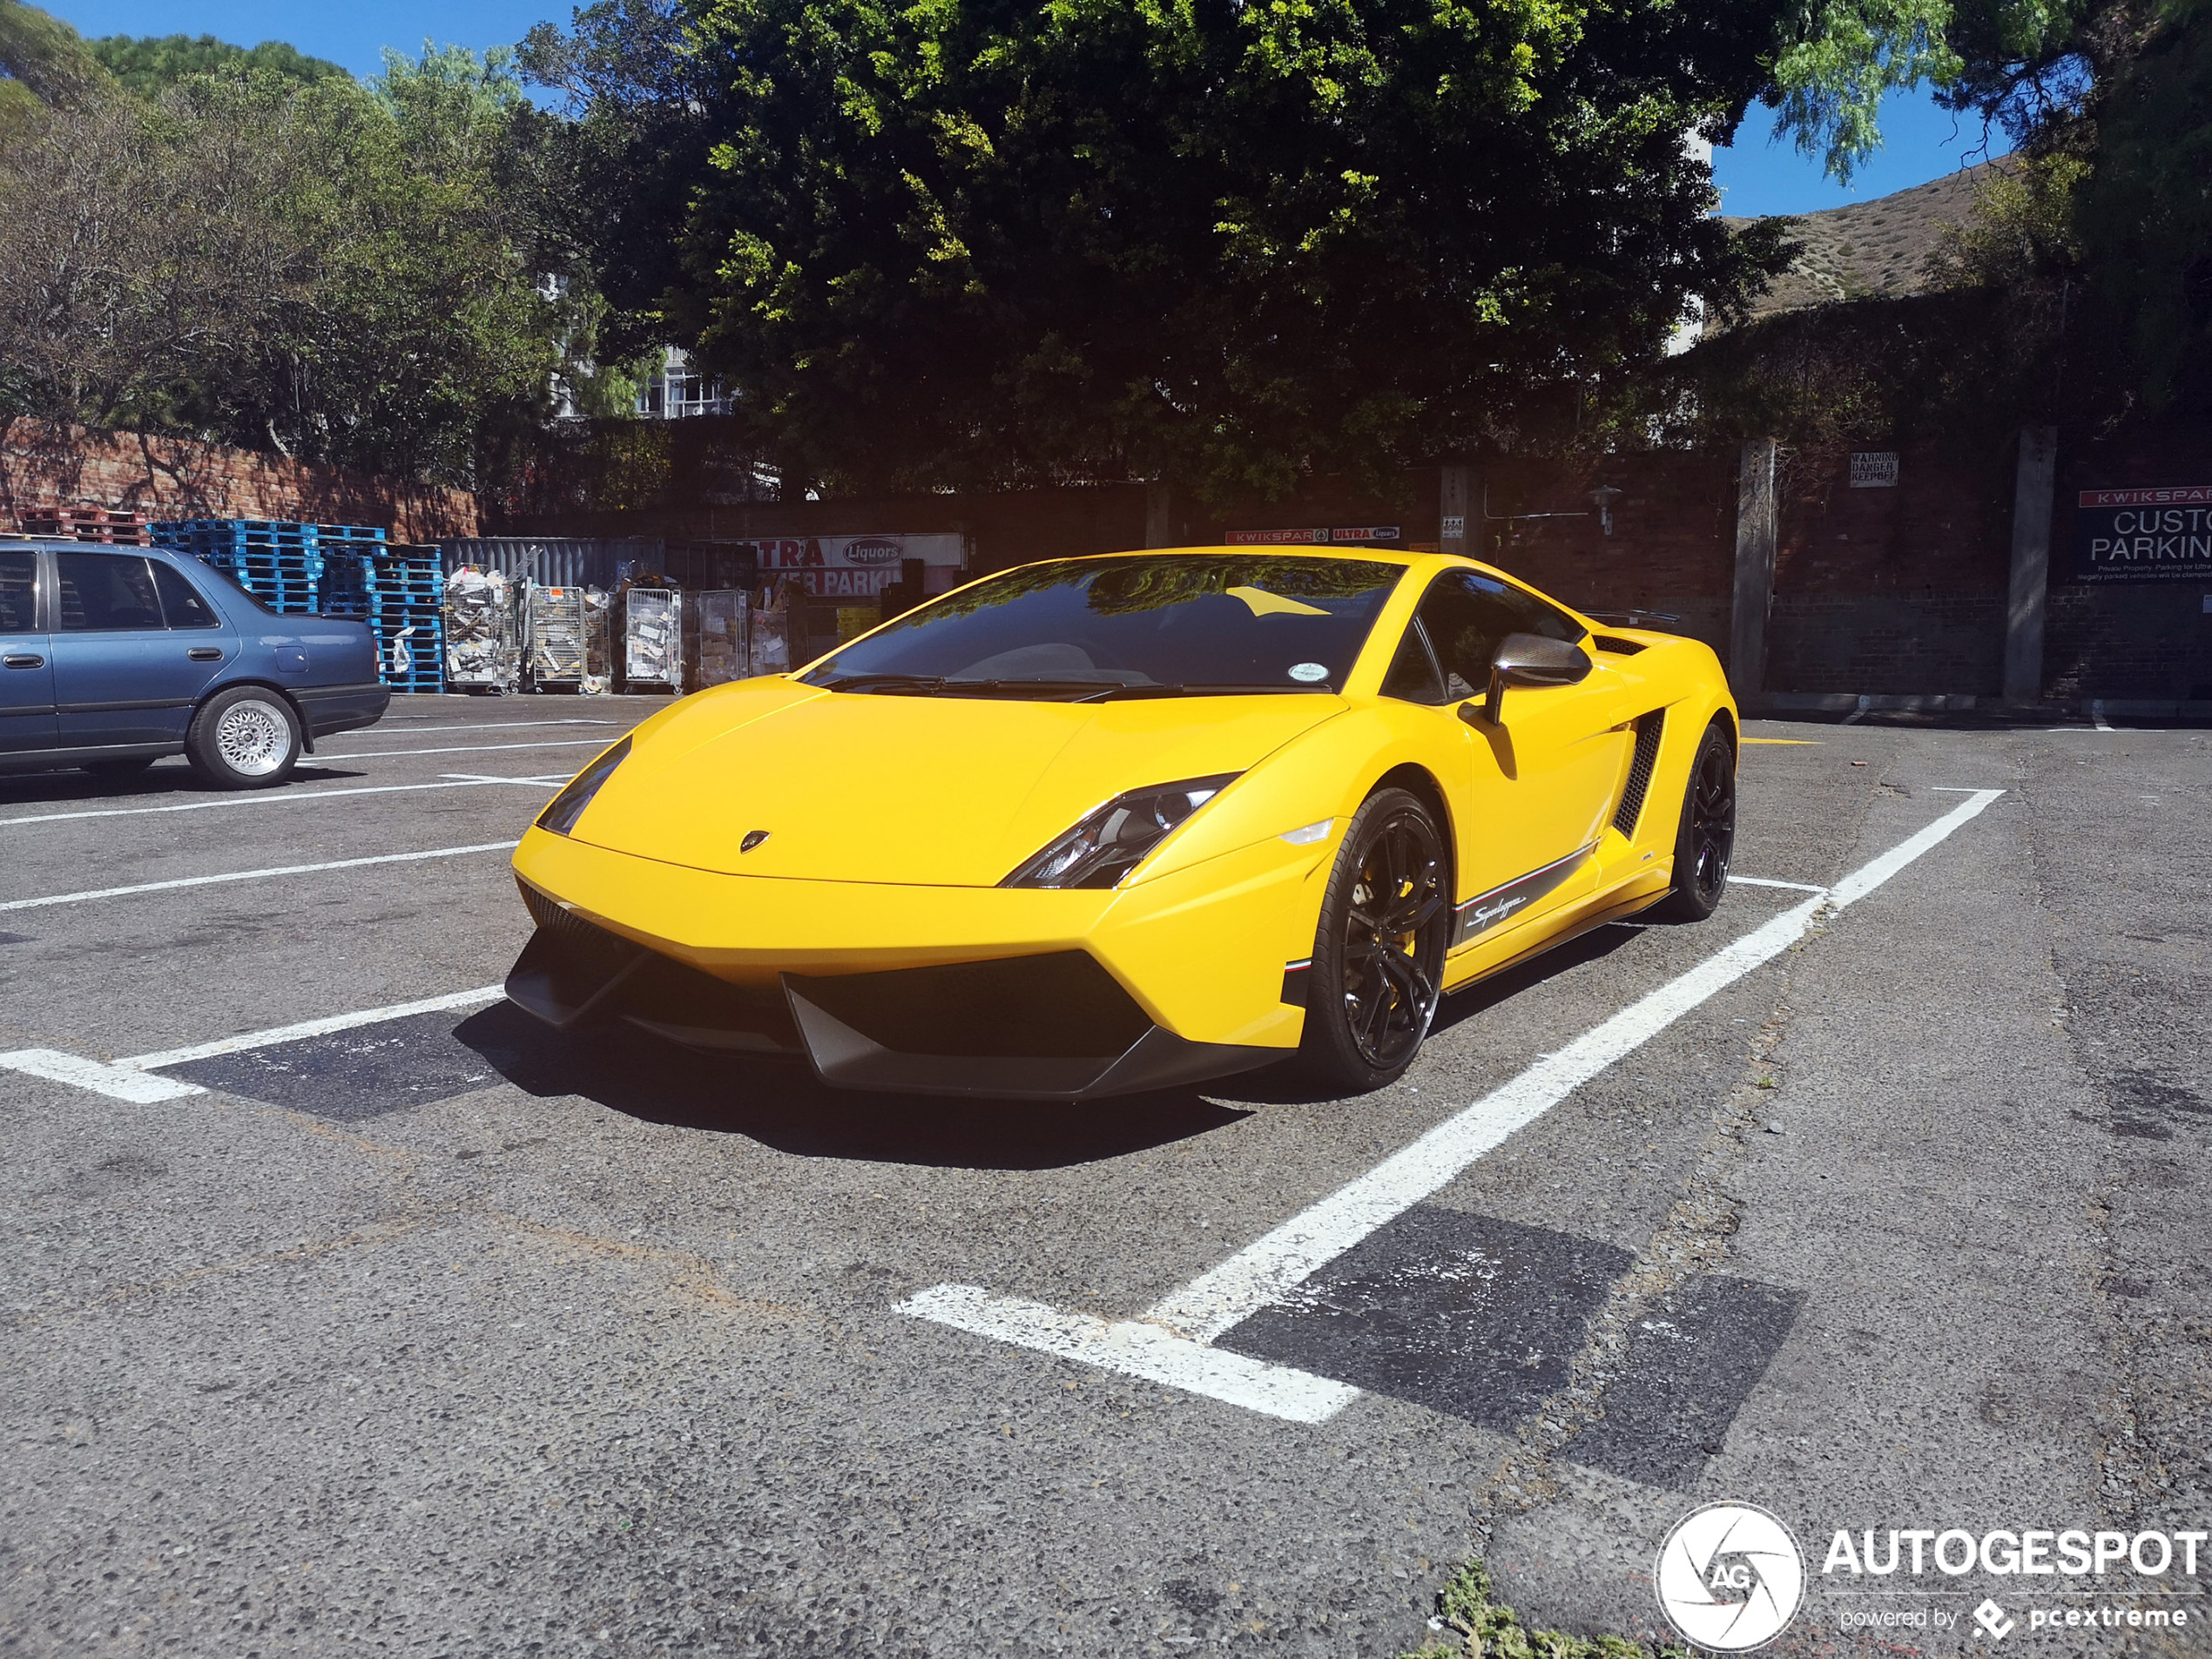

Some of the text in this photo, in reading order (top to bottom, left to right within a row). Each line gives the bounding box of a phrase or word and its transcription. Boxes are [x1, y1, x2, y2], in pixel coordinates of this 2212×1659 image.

[1851, 453, 1898, 462] WARNING
[1852, 462, 1893, 471] DANGER
[2114, 509, 2212, 535] CUST
[1237, 530, 1312, 543] KWIKSPAR
[1334, 529, 1371, 540] ULTRA
[743, 537, 899, 567] TRA Liquors
[2091, 536, 2211, 561] PARKIN
